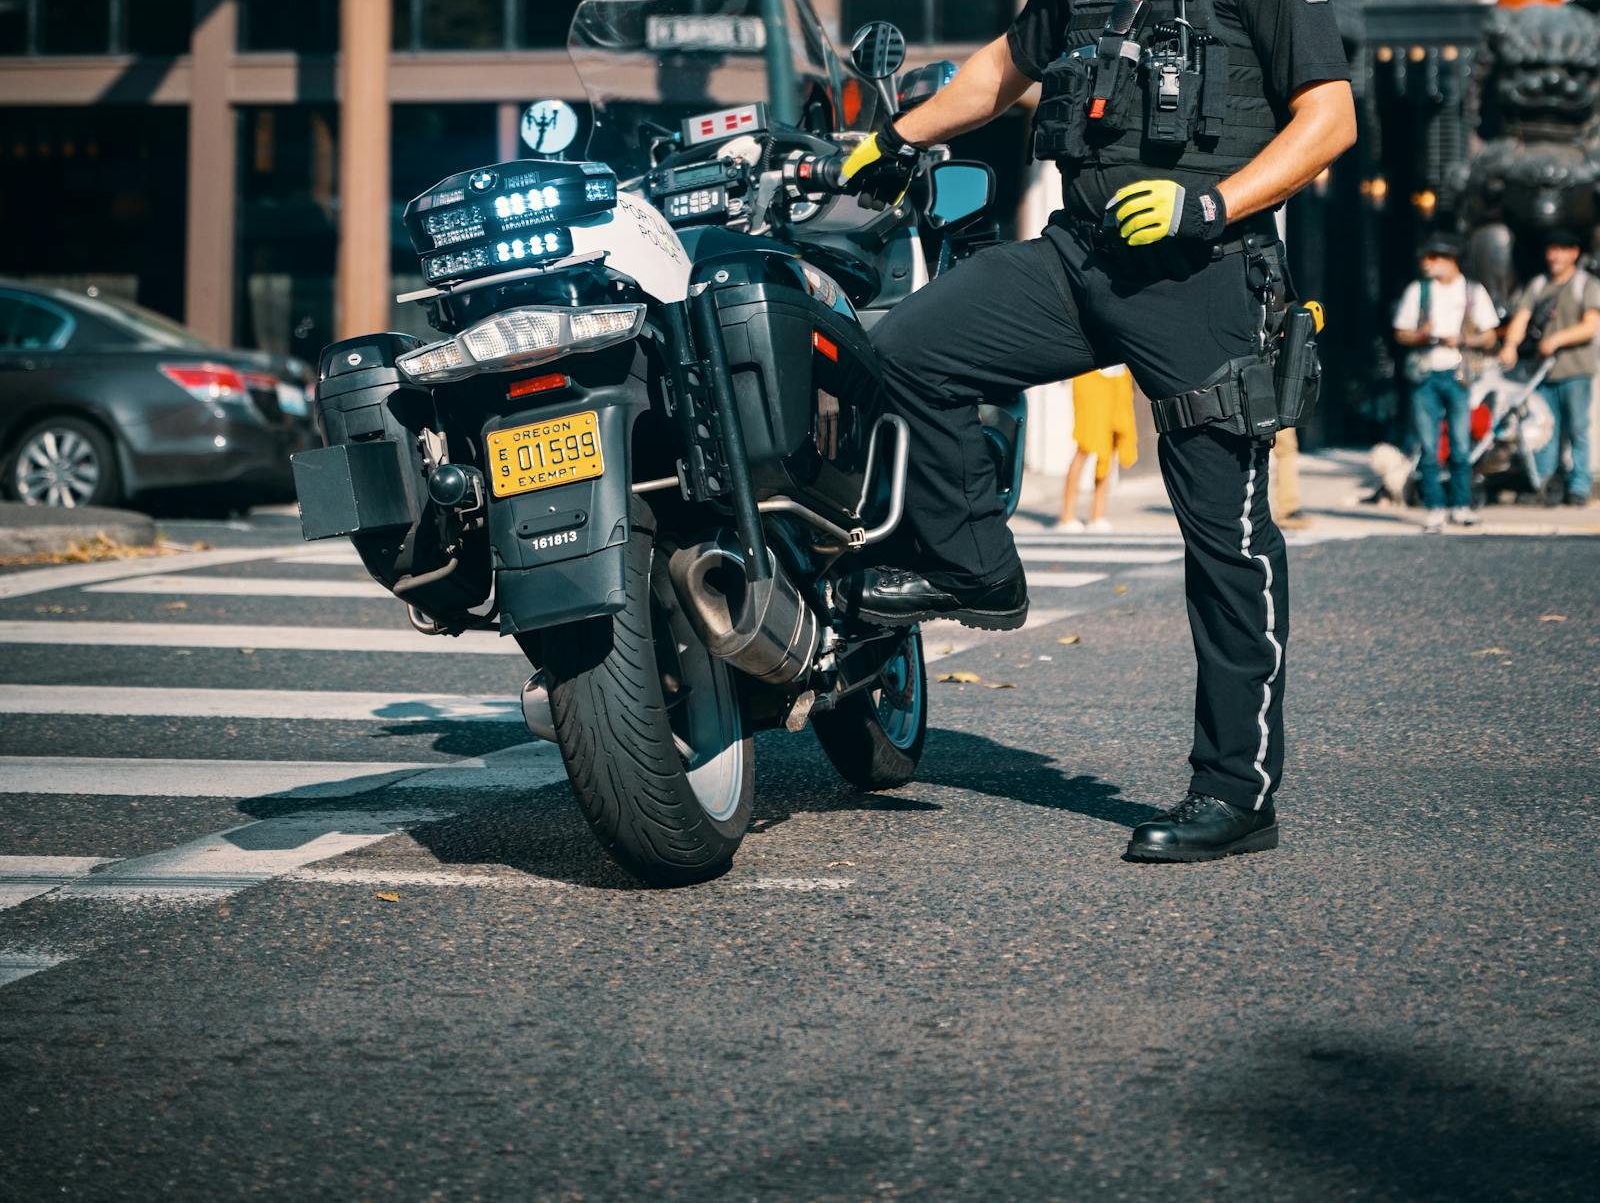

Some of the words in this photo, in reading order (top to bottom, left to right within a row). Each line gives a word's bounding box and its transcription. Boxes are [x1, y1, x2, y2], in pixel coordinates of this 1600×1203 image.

[513, 421, 571, 442] OREGON
[517, 431, 597, 471] 01599
[518, 466, 578, 487] EXEMPT
[532, 530, 578, 550] 161813
